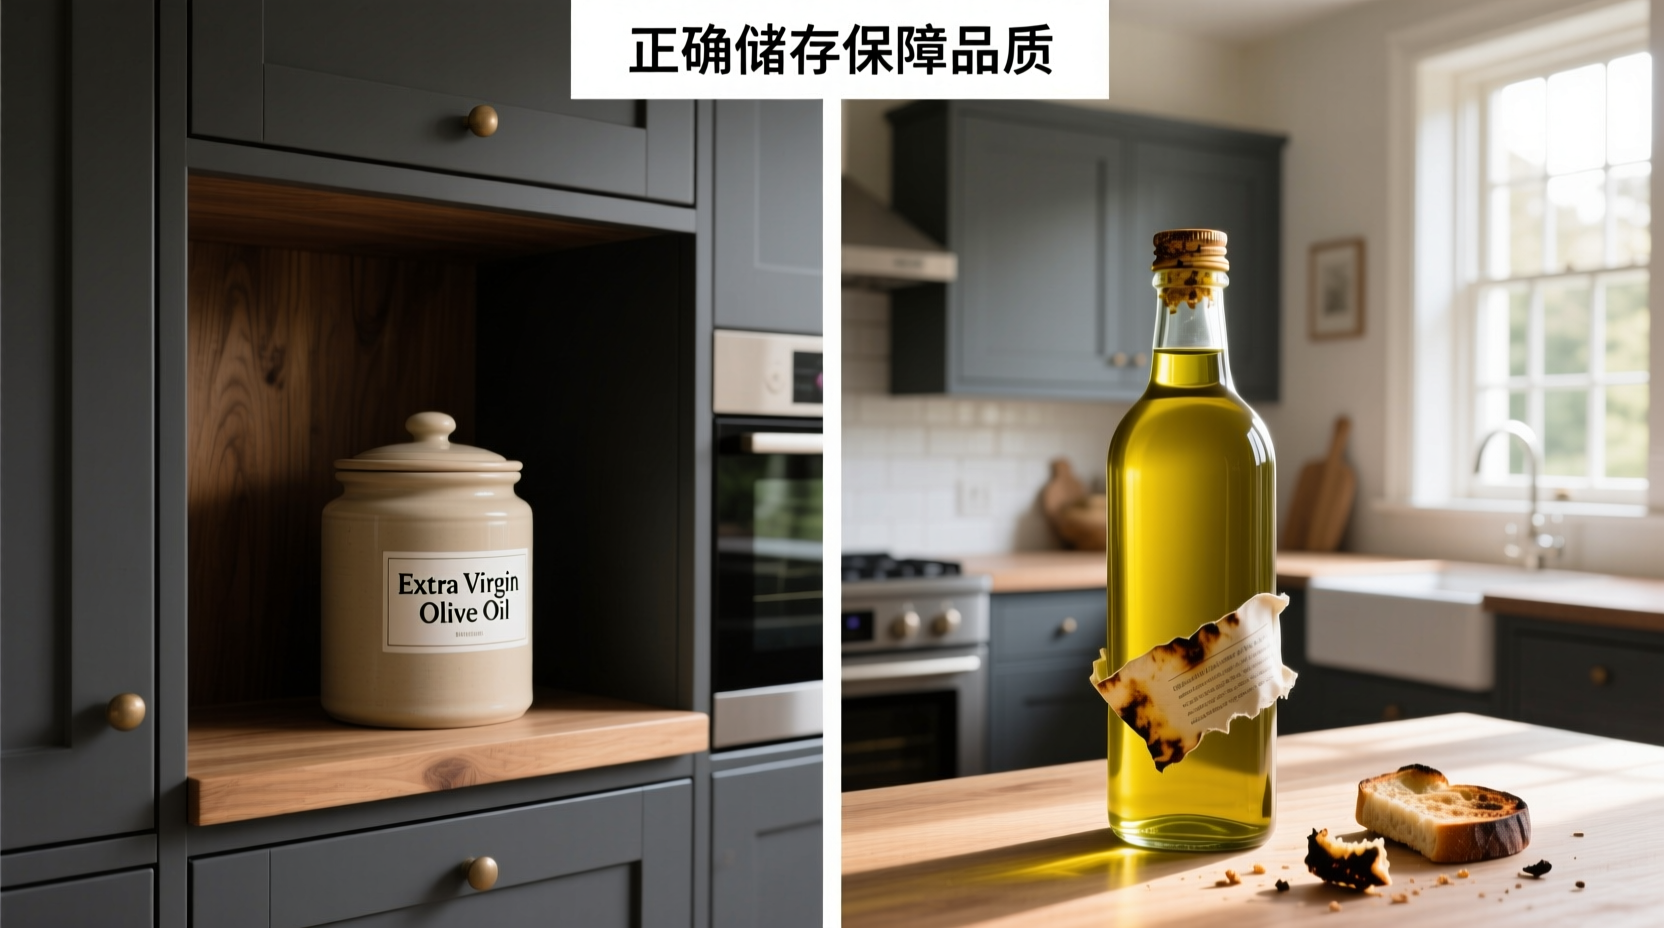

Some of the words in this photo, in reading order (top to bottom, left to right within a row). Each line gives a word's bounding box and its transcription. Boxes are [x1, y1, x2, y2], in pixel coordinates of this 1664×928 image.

[398, 572, 459, 595] Extra
[462, 570, 519, 599] Virgin
[419, 600, 478, 625] Olive
[482, 598, 510, 621] Oil
